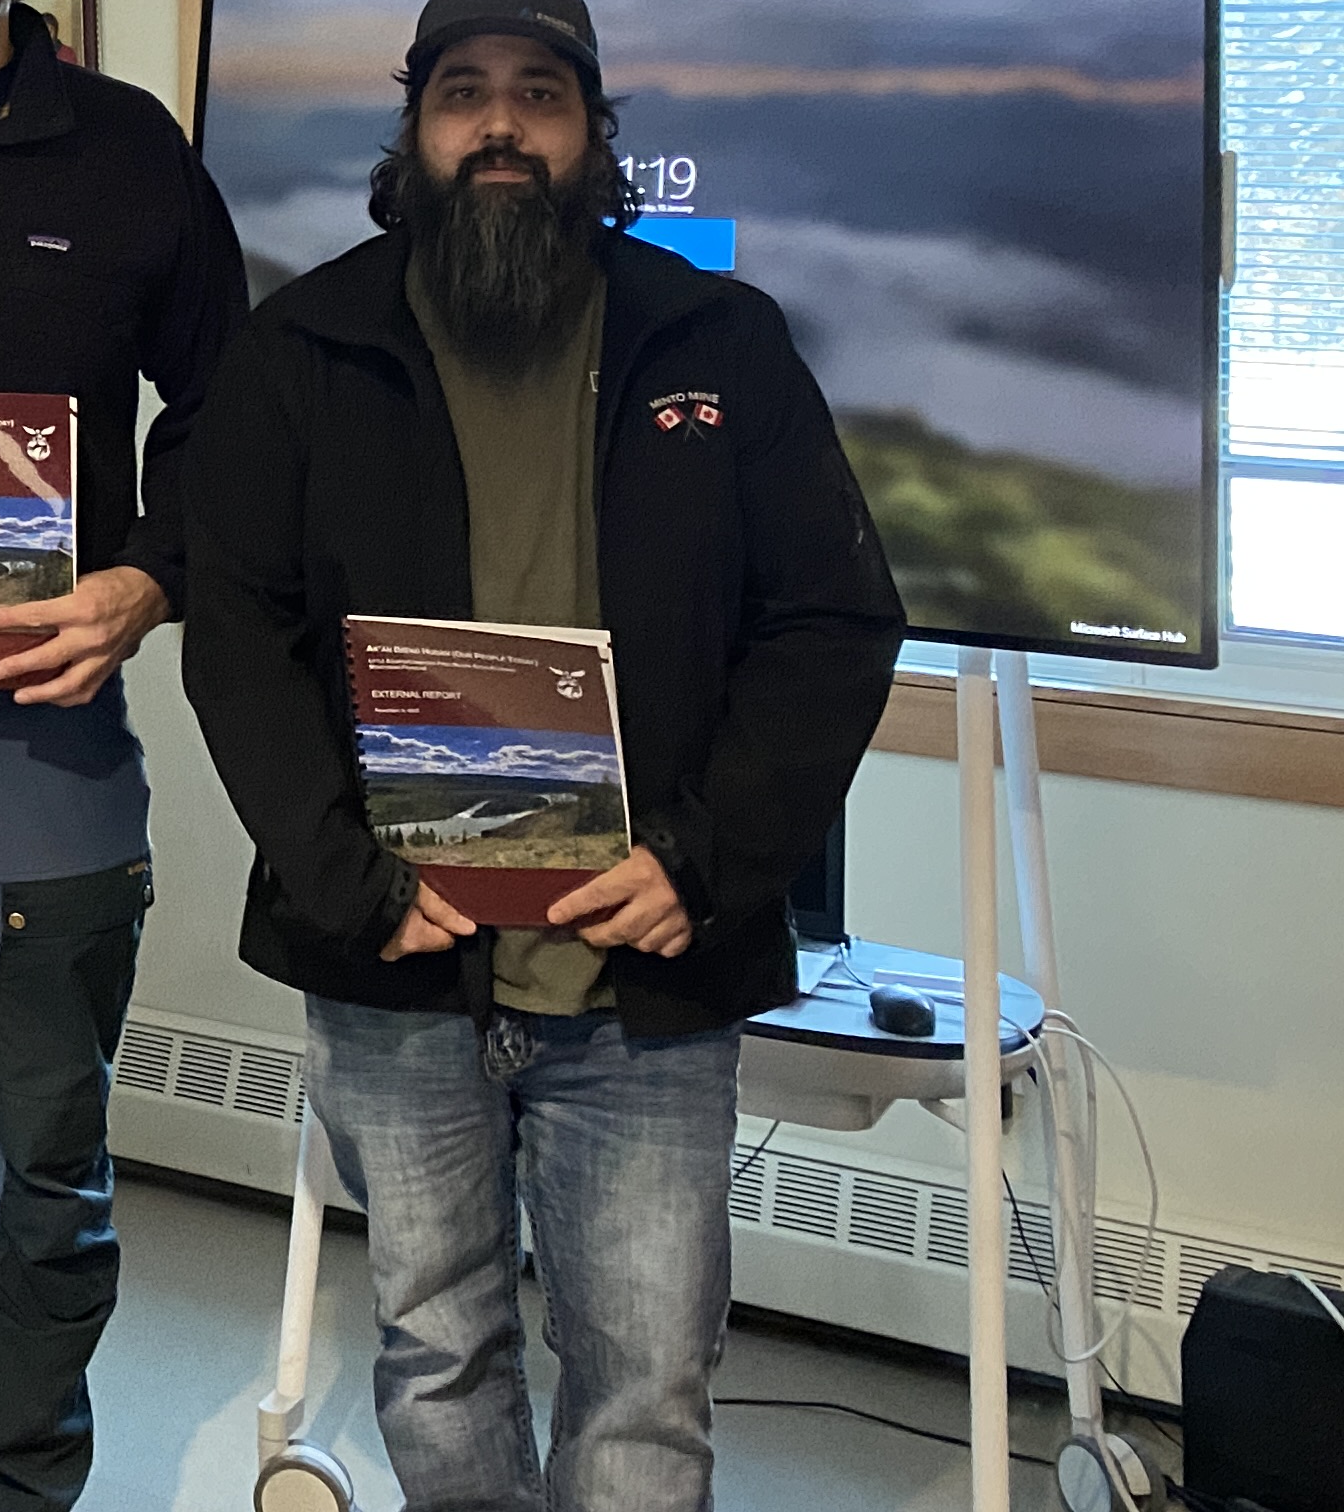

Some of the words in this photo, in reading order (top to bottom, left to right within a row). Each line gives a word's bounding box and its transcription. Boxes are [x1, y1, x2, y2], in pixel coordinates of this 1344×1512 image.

[649, 392, 686, 409] MINTO
[688, 391, 720, 404] MINE
[371, 690, 421, 699] EXTERNAL
[422, 691, 462, 700] REPORT
